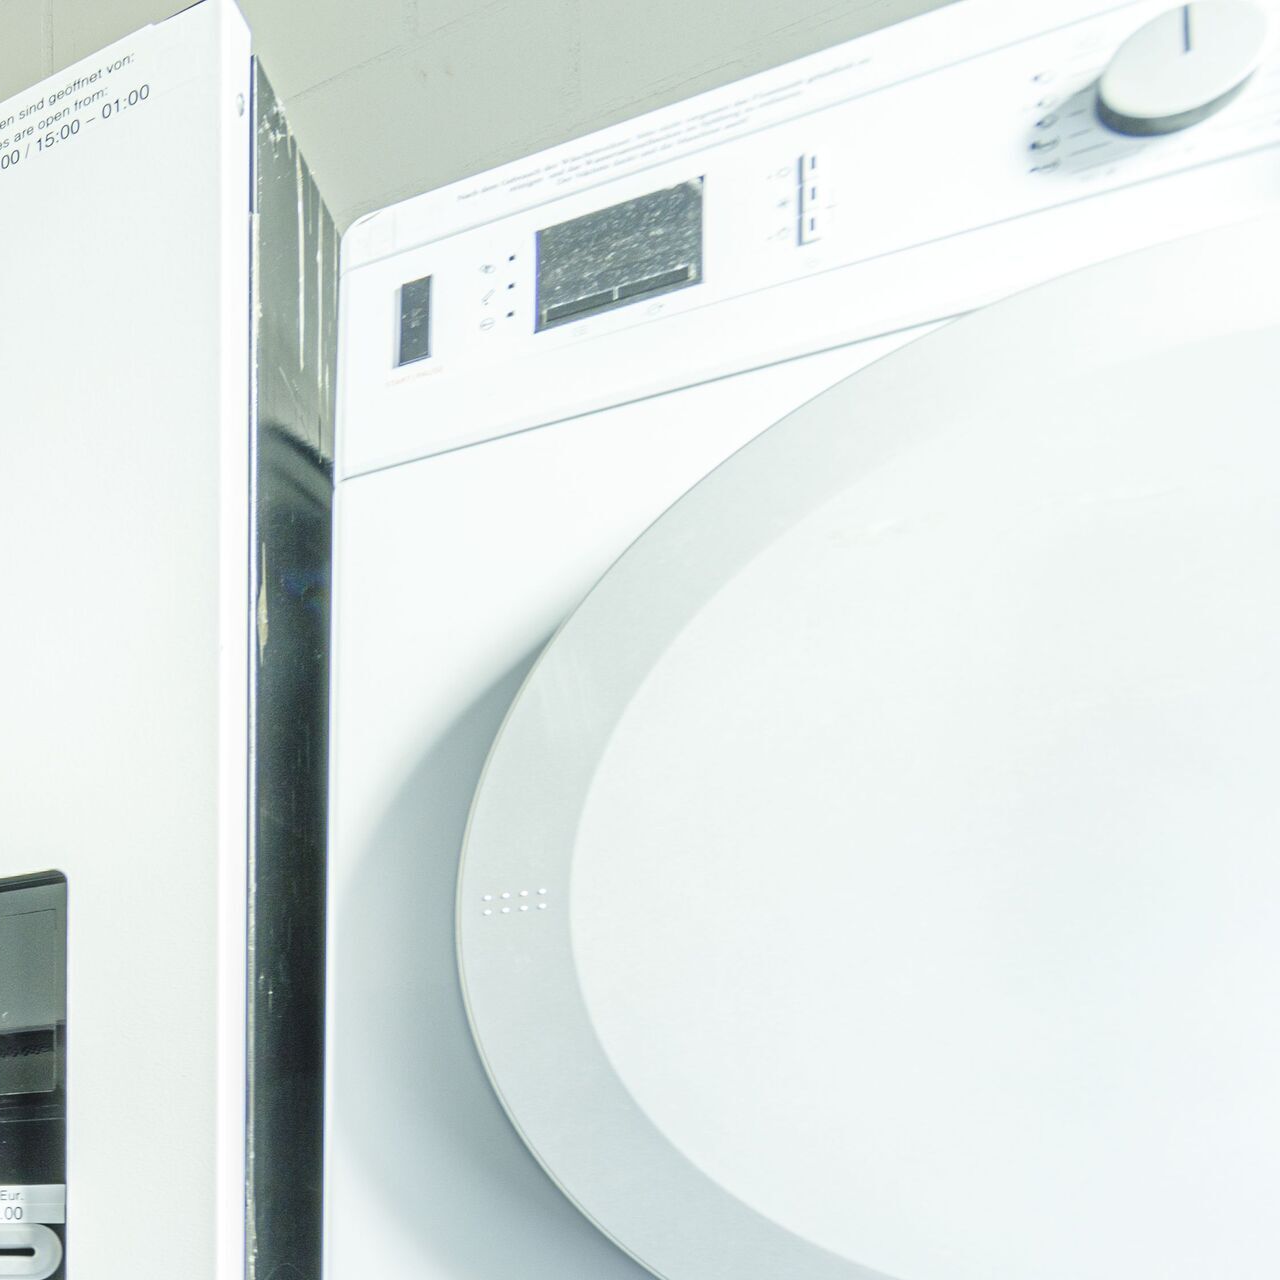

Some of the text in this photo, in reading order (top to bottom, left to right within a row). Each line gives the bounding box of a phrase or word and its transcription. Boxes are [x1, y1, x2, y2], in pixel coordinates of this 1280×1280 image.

[14, 125, 34, 142] are
[38, 108, 69, 130] open
[75, 86, 108, 111] from:
[19, 100, 44, 120] sind
[49, 69, 102, 105] geöffnet
[106, 52, 135, 75] von:
[36, 119, 80, 152] 15:00
[102, 84, 150, 120] 01:00
[0, 1190, 24, 1201] Eur.
